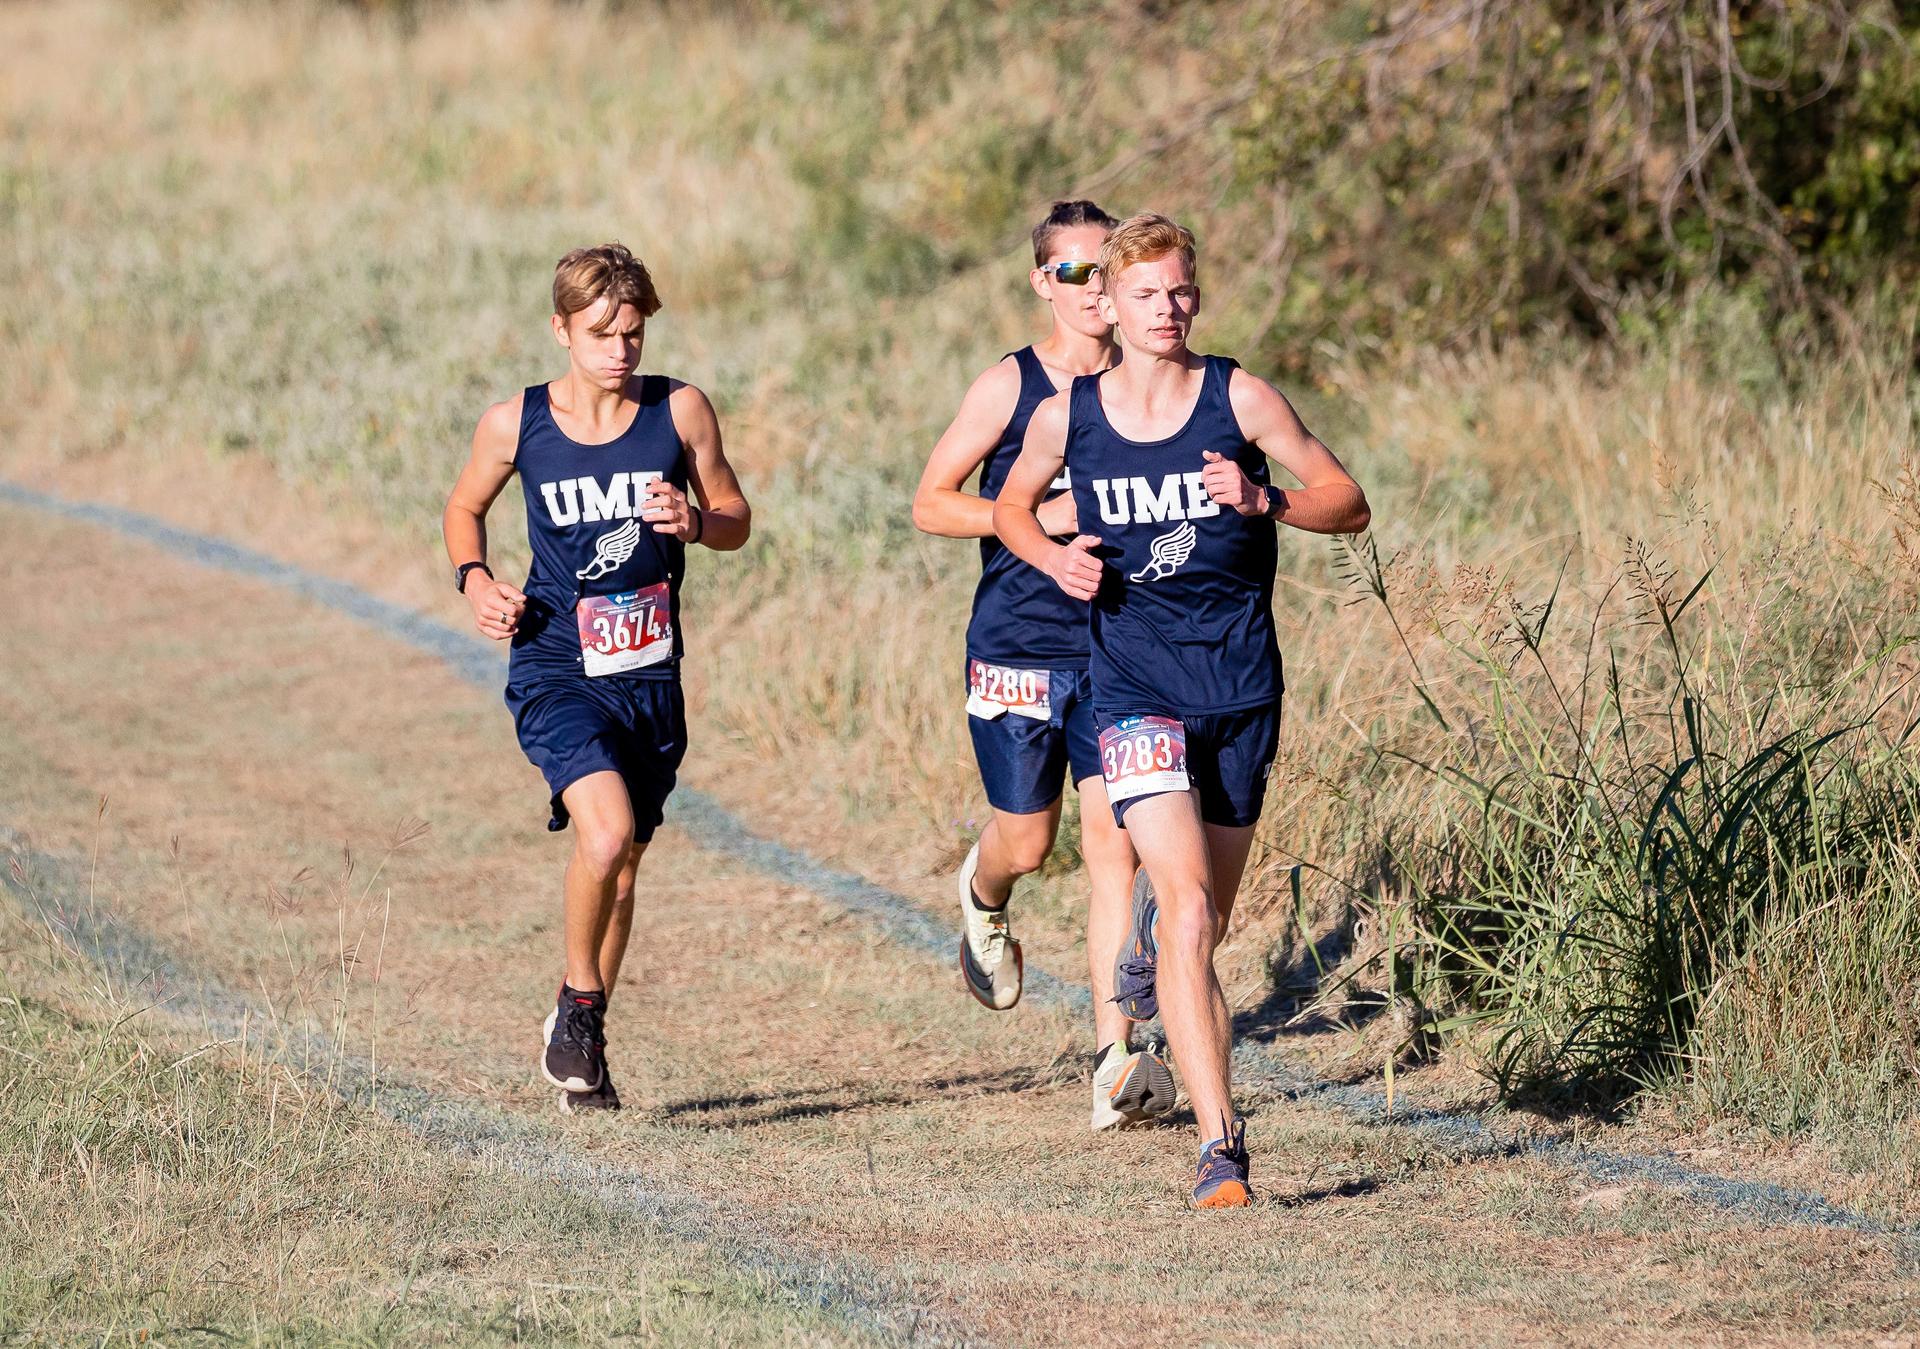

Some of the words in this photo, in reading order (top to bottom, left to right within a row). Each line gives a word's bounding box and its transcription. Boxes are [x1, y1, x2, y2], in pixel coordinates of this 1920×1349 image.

[540, 471, 663, 526] UME
[1092, 471, 1220, 525] UME
[593, 605, 661, 653] 3674
[975, 663, 1037, 703] 3280
[1104, 733, 1172, 781] 3283
